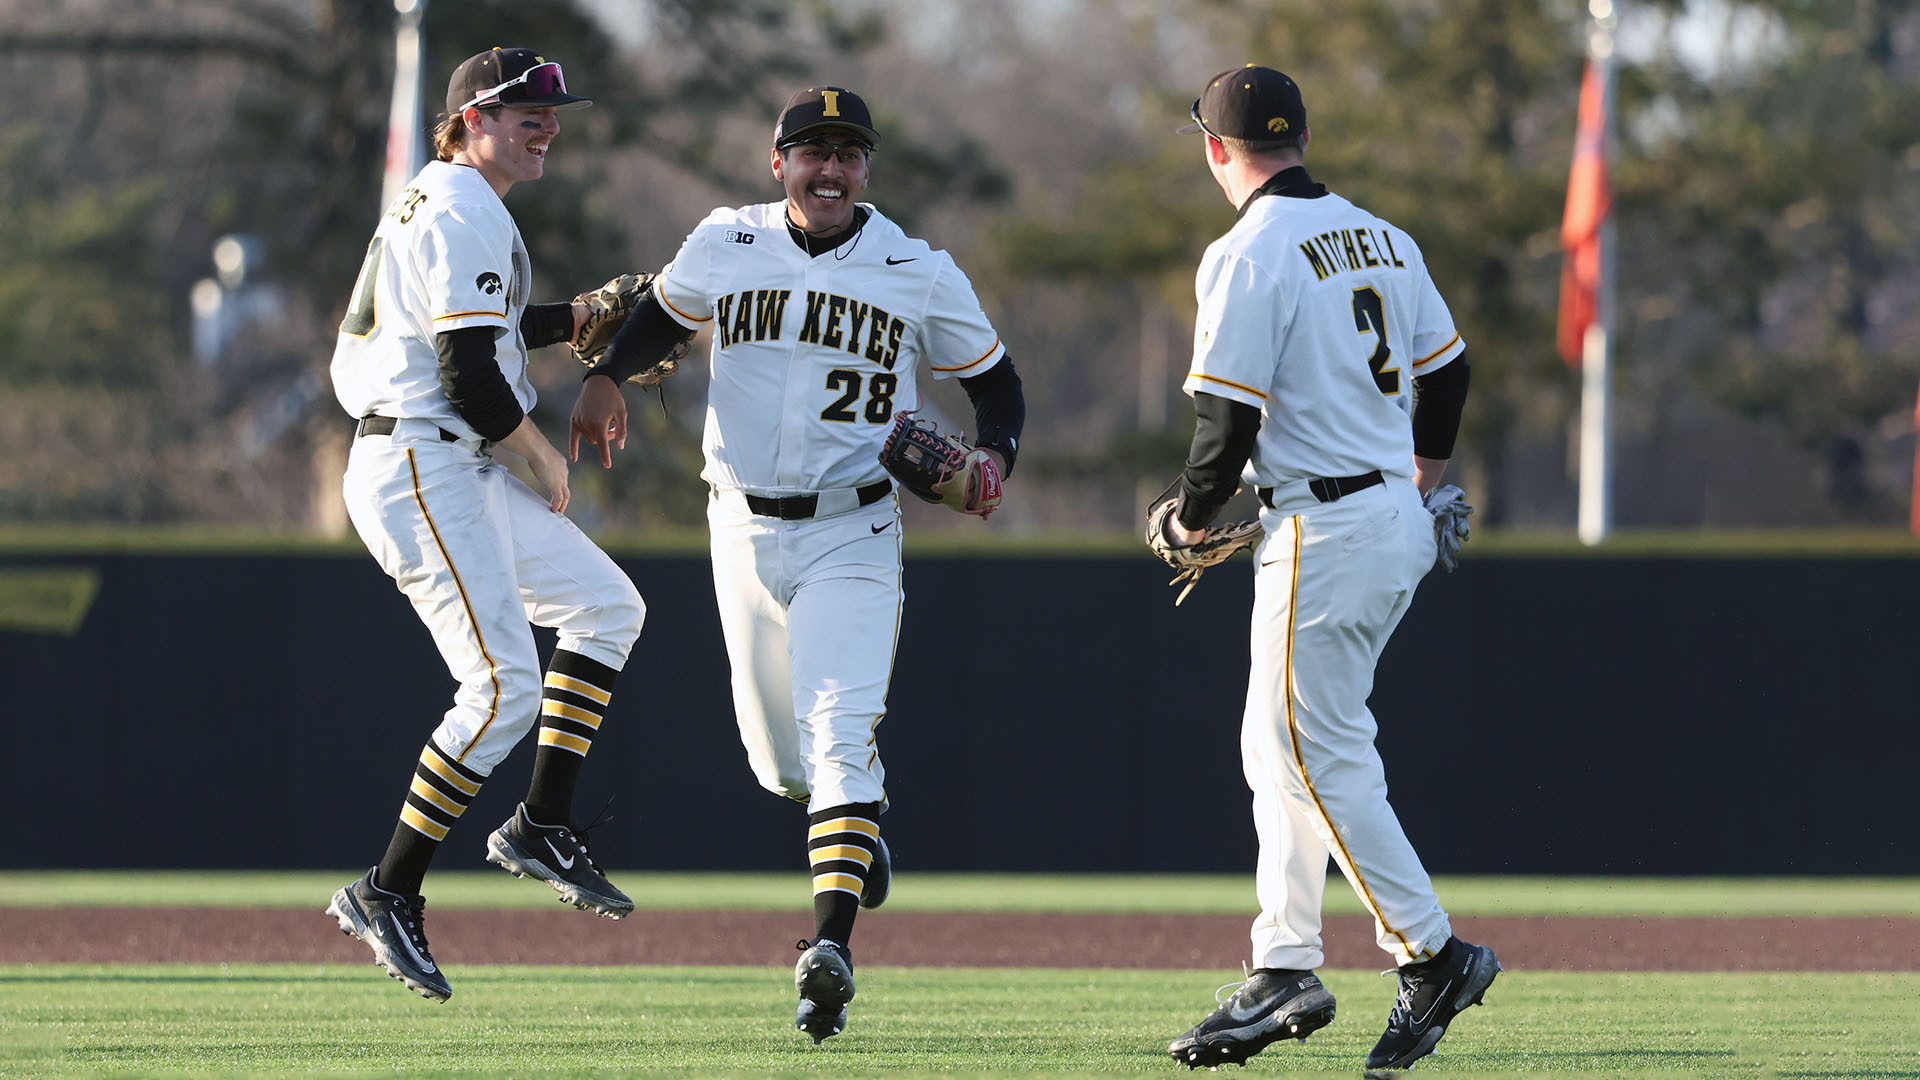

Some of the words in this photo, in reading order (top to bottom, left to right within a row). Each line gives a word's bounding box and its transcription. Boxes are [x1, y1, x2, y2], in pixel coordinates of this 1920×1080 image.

[821, 90, 841, 117] I
[1298, 228, 1406, 282] MITCHELL
[1351, 285, 1401, 396] 2
[819, 368, 898, 425] 28
